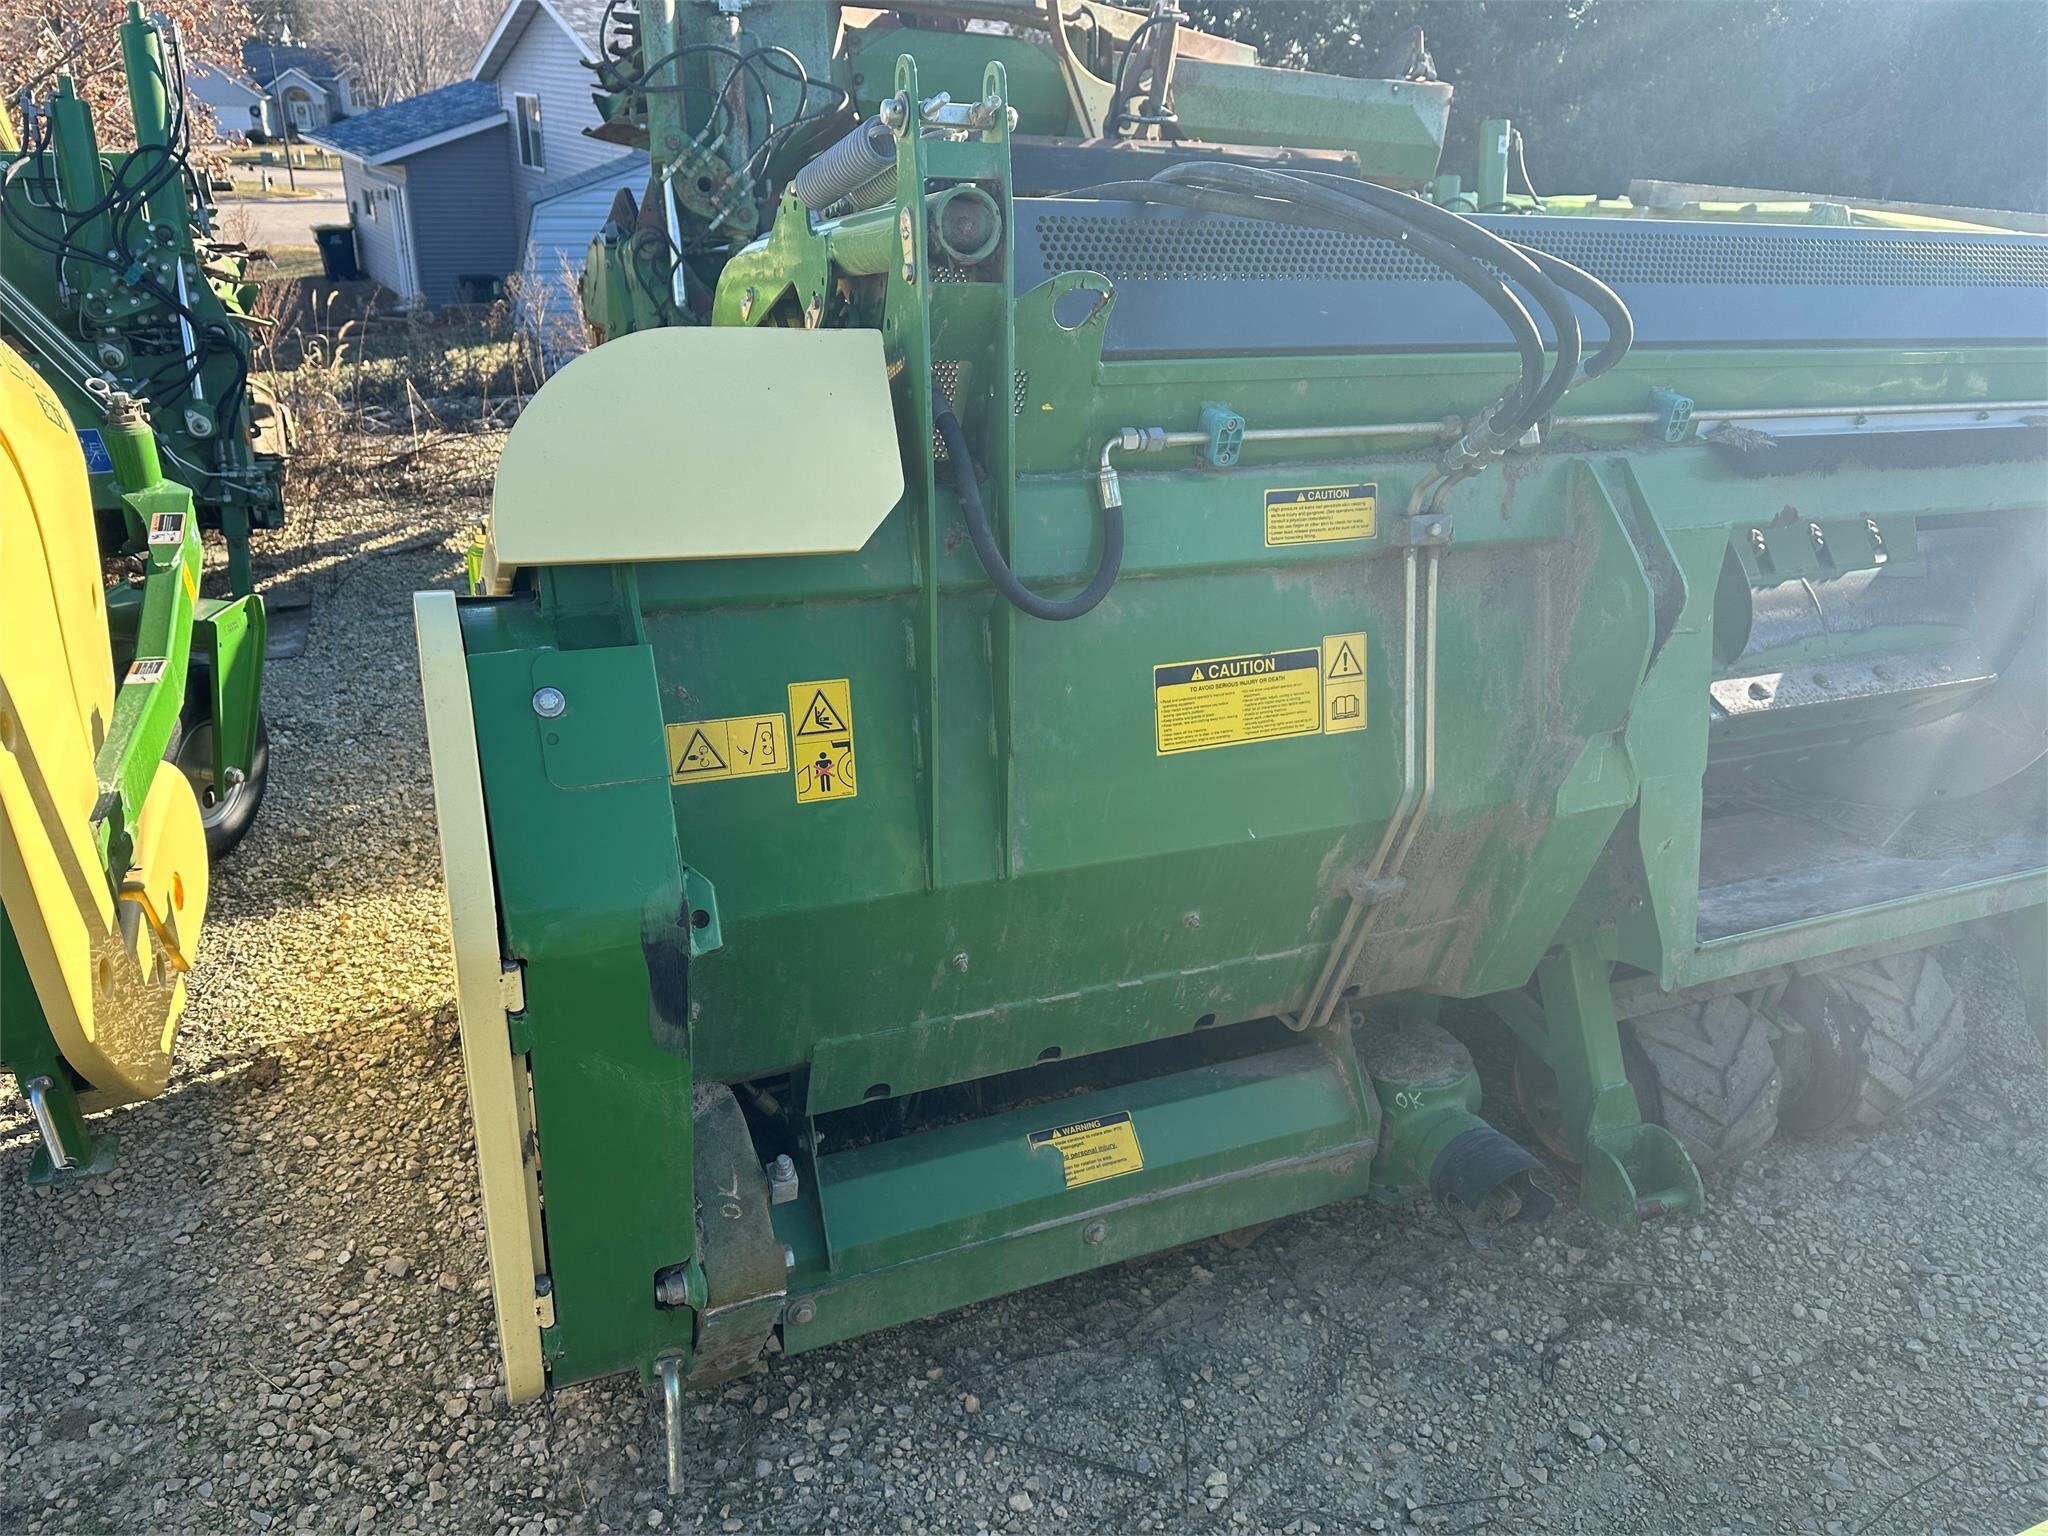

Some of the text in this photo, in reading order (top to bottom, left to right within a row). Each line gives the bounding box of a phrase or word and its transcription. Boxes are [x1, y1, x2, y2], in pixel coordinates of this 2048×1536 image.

[1308, 489, 1350, 500] CAUTION
[1208, 657, 1275, 678] CAUTION
[1215, 681, 1238, 689] SERIOUS
[1240, 679, 1258, 687] INJURY
[1396, 1092, 1424, 1109] OK
[1062, 1120, 1101, 1135] WARNING
[1071, 1148, 1097, 1159] personal
[716, 1164, 742, 1219] OK
